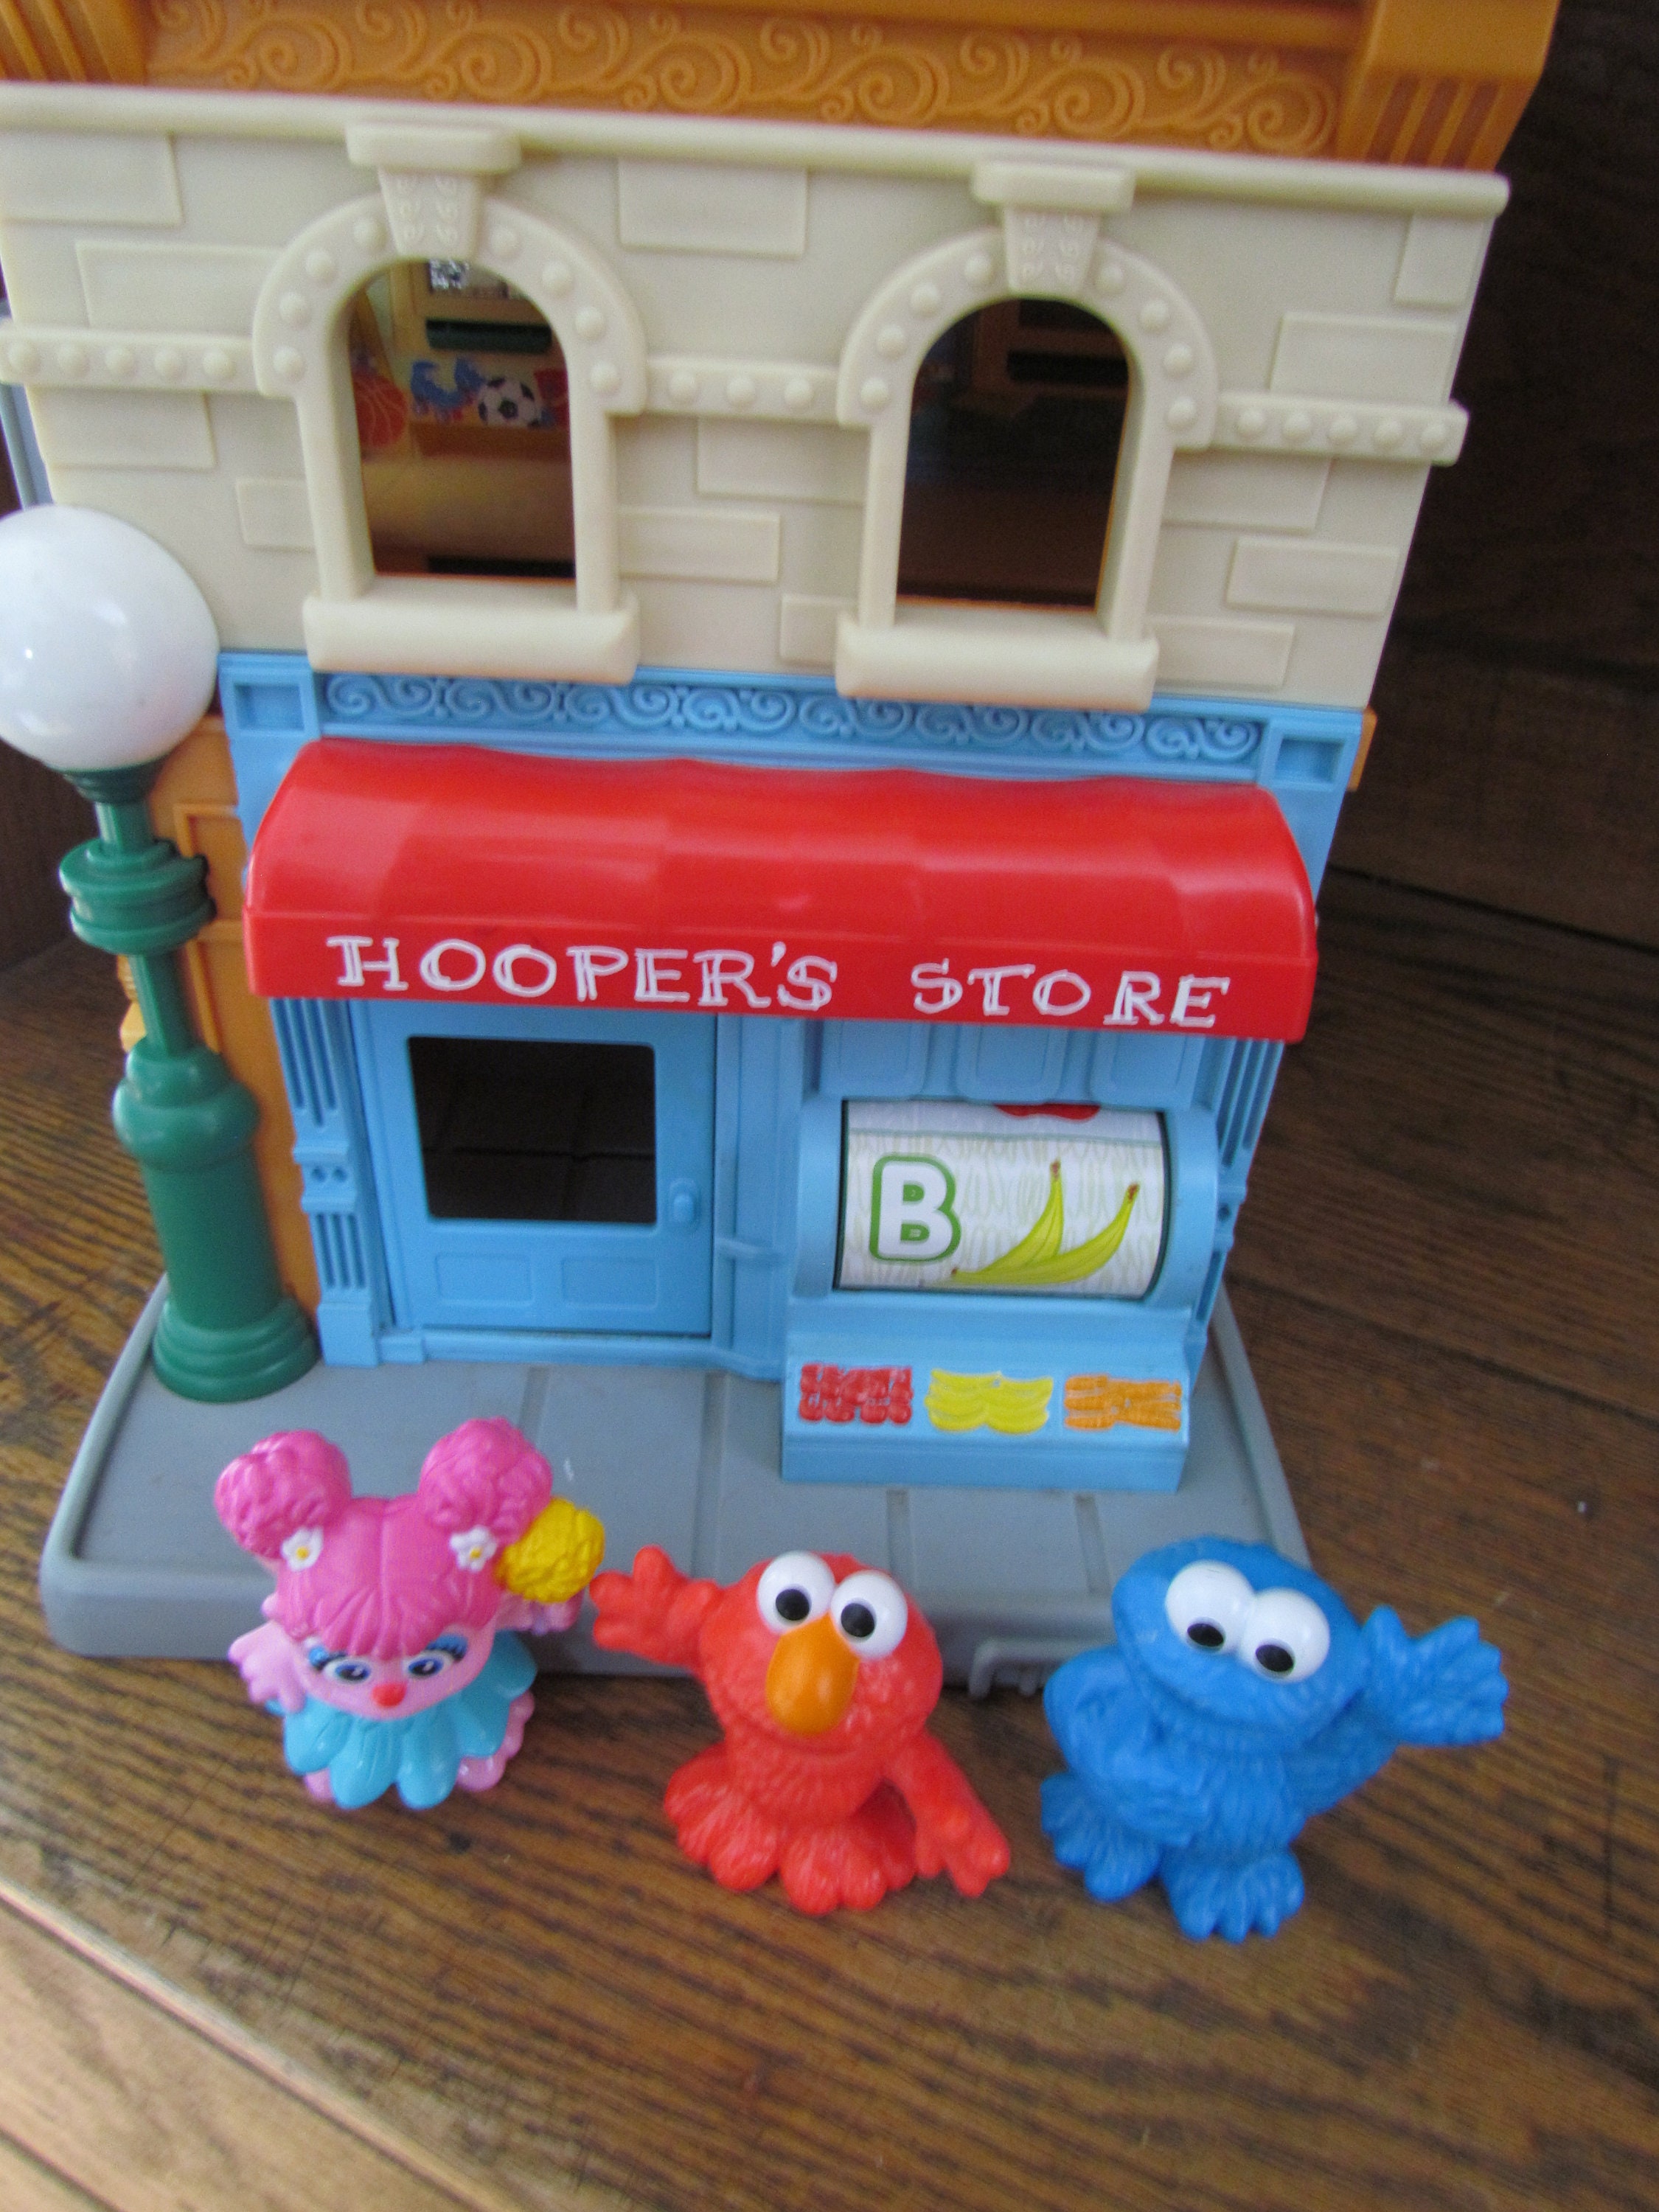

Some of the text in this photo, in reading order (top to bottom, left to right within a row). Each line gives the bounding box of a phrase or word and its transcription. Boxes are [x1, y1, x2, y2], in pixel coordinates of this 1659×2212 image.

[326, 935, 1231, 1028] HOOPER'S STORE
[869, 1153, 961, 1263] B
